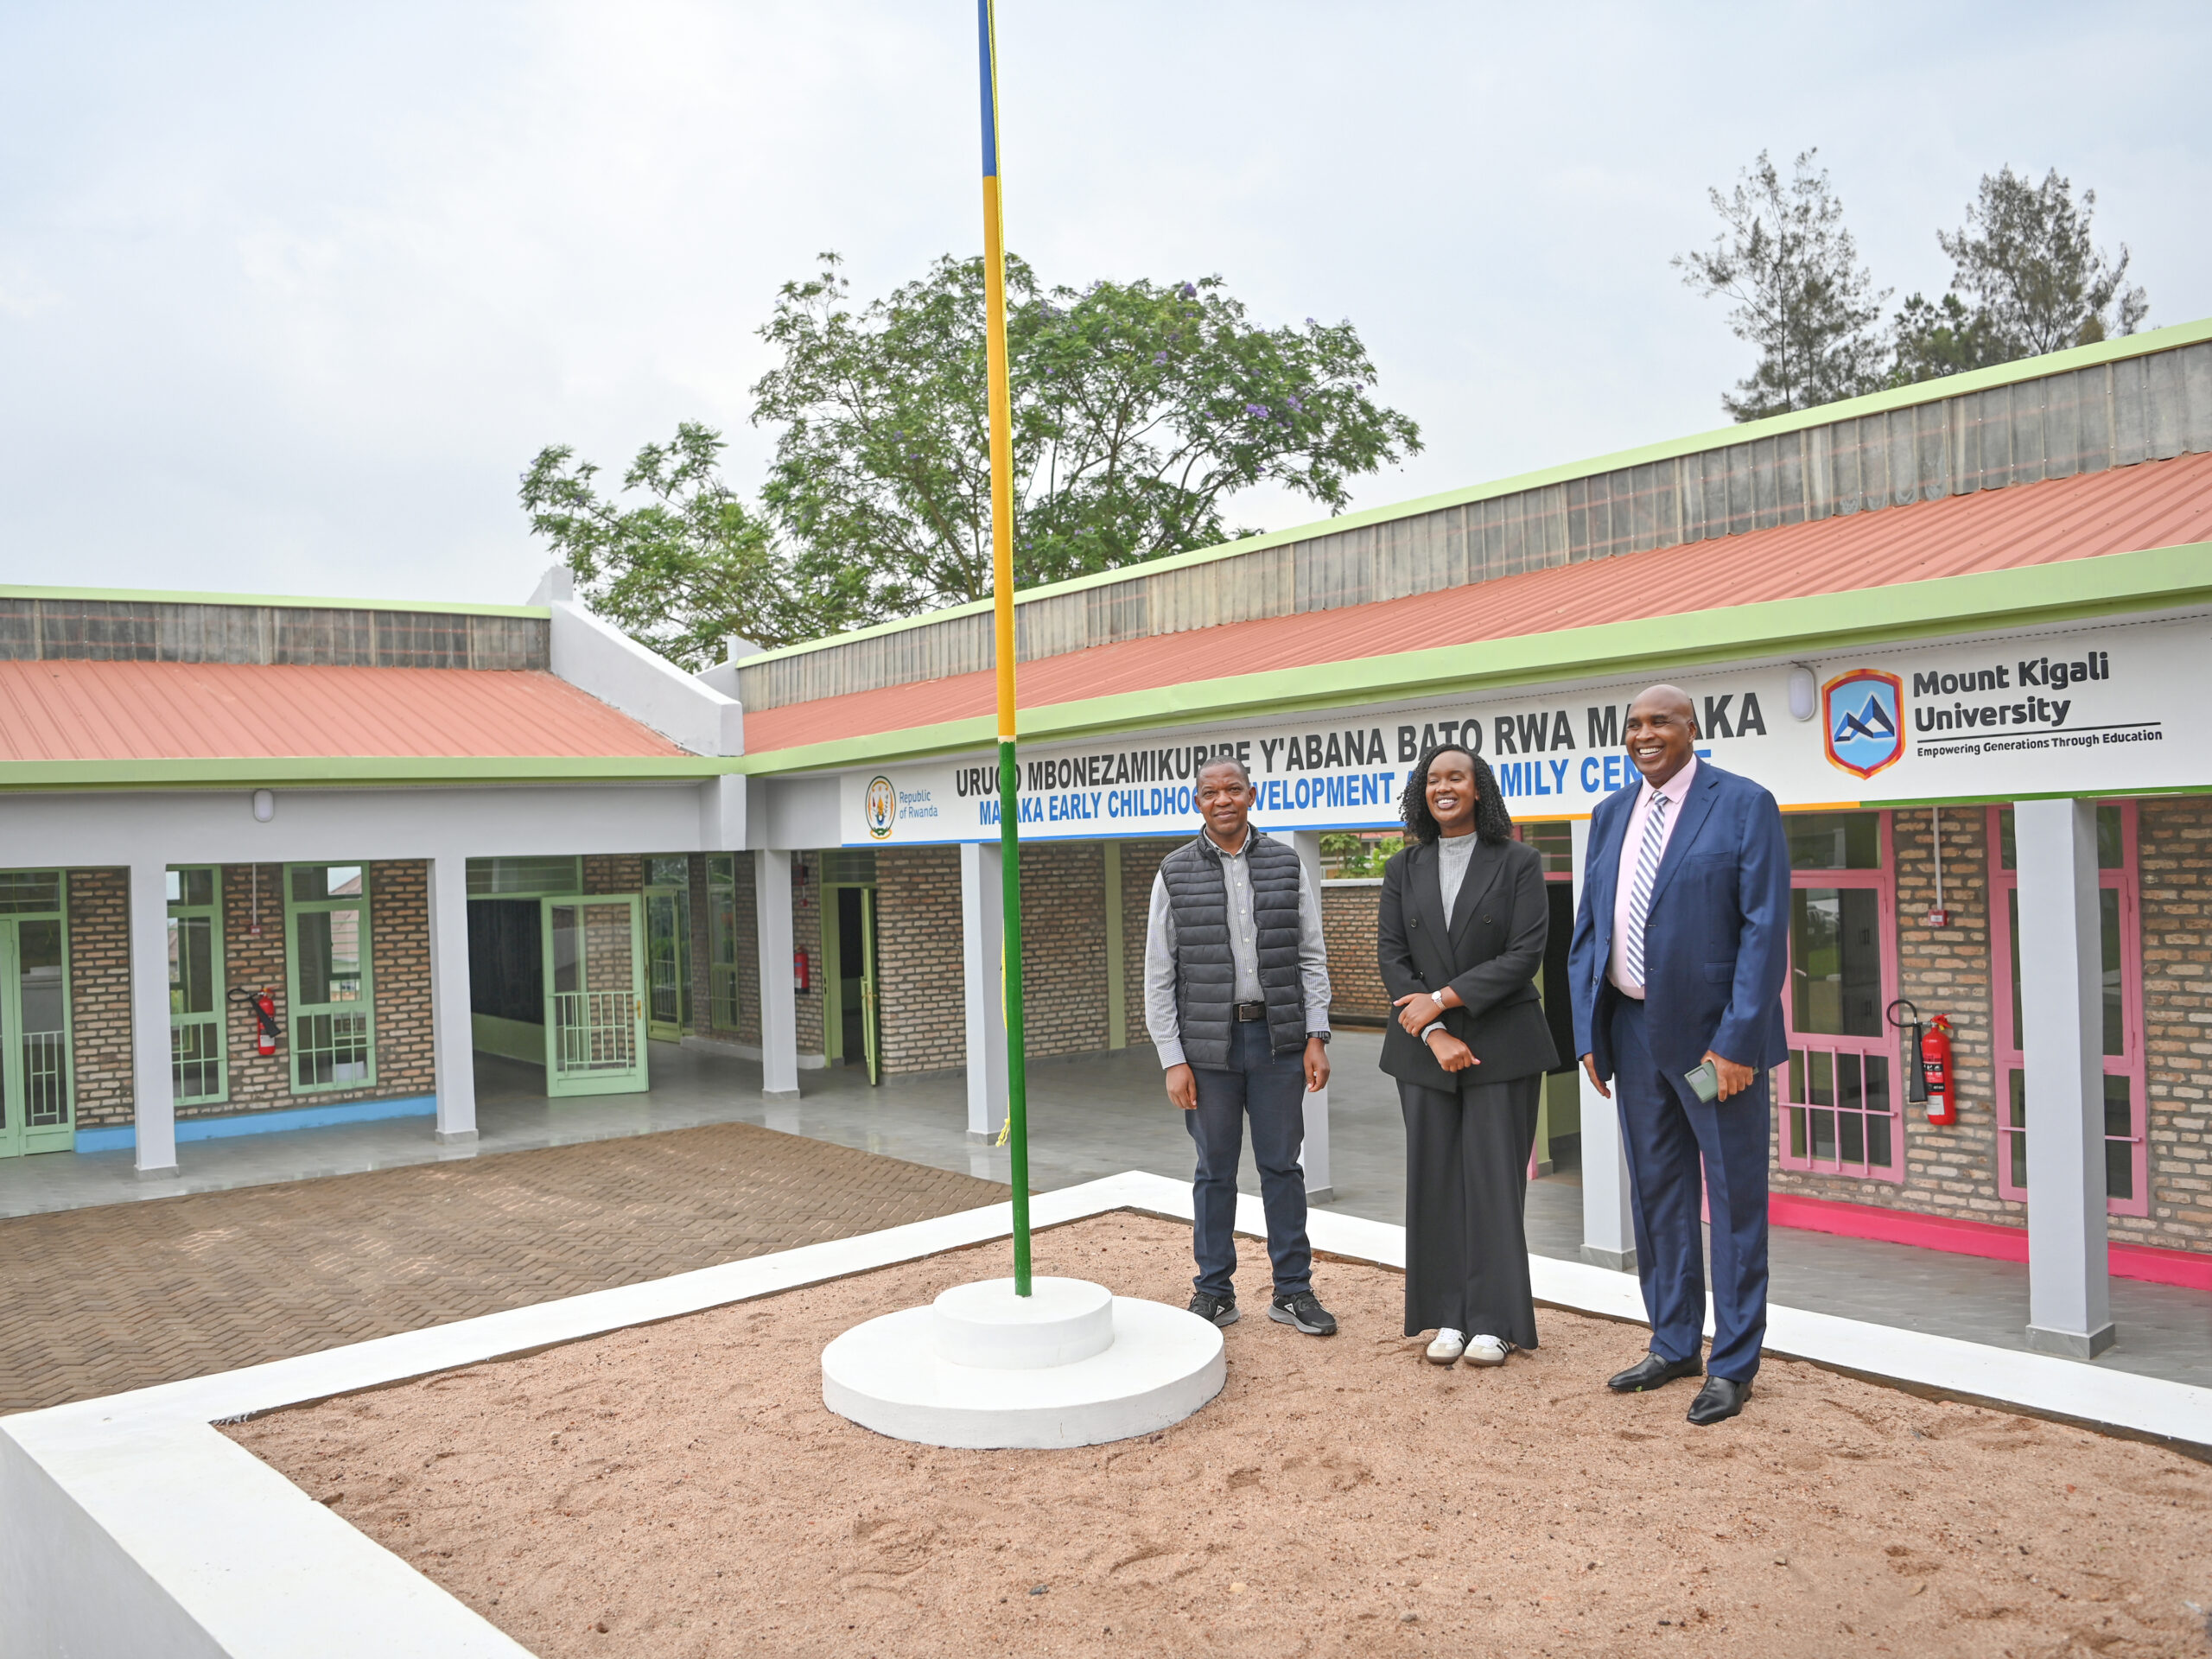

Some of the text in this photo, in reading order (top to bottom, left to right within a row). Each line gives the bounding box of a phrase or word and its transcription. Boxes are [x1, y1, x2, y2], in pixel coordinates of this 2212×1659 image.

[1913, 651, 2109, 697] Mount Kigali
[1915, 695, 2071, 732] University
[956, 764, 1021, 798] URU
[1259, 728, 1387, 773] Y'ABANA
[1397, 719, 1483, 763] BATO
[1494, 709, 1576, 756] RWA
[1916, 729, 2163, 759] Empowering Generations Through Education
[899, 789, 931, 805] Republic
[1049, 791, 1103, 822] EARLY
[1108, 783, 1203, 818] CHILDHO
[1247, 772, 1395, 812] VELOPMENT
[1488, 759, 1569, 798] MILY
[899, 804, 938, 819] of Rwanda
